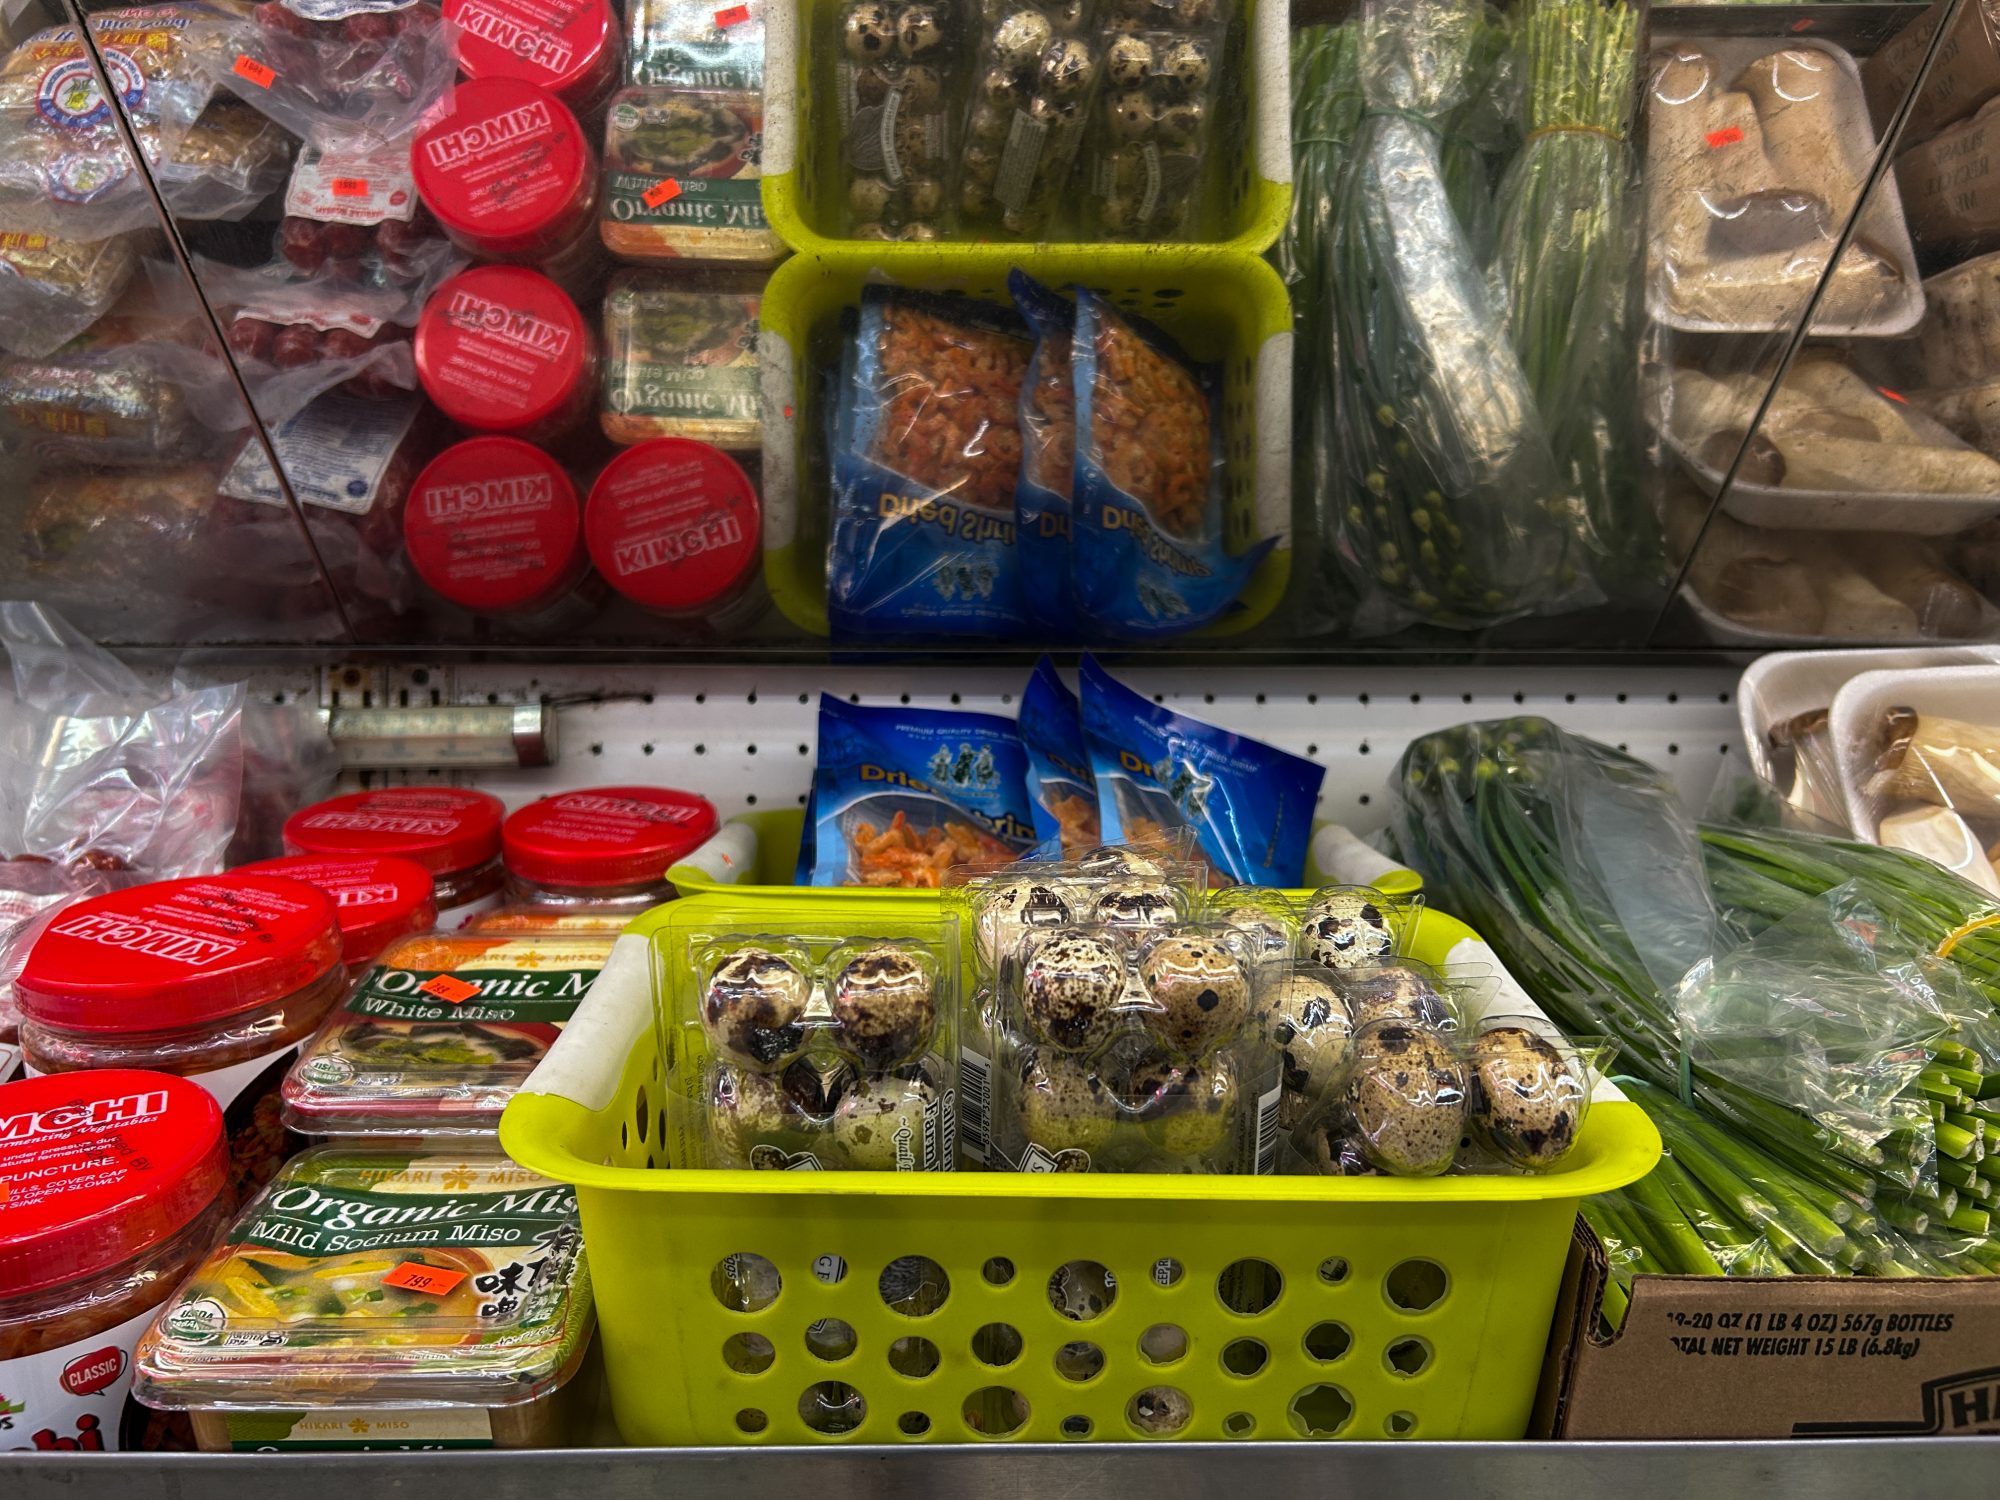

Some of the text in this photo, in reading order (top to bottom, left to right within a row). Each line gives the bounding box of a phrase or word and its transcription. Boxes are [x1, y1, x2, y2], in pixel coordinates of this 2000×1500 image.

[1119, 750, 1155, 778] Dr
[50, 915, 237, 965] KIMCHI
[363, 997, 516, 1021] White Miso
[77, 1115, 158, 1136] Vegetables
[923, 1097, 940, 1165] Farm
[3, 1150, 39, 1162] under
[24, 1175, 126, 1200] OPEN SLOWLY
[44, 1173, 96, 1188] COVER
[98, 1168, 128, 1180] CAP
[357, 1169, 543, 1185] HIKARI MISO
[269, 1185, 577, 1232] Organic Mis
[250, 1219, 522, 1253] Mild Sodium Miso
[403, 1274, 433, 1288] 799
[1767, 1314, 1786, 1331] LB
[1791, 1313, 1803, 1331] 4
[1806, 1314, 1837, 1332] OZ)
[1841, 1314, 1883, 1336] 567g
[1886, 1313, 1954, 1332] BOTTLES
[1711, 1338, 1744, 1356] NET
[1747, 1338, 1811, 1356] WEIGHT
[1814, 1337, 1834, 1356] 15
[1838, 1338, 1858, 1356] LB
[1861, 1336, 1920, 1360] (6.8kg)
[69, 1358, 117, 1387] CLASSIC
[1949, 1384, 2000, 1429] H
[300, 1421, 410, 1431] HIKARI MISO
